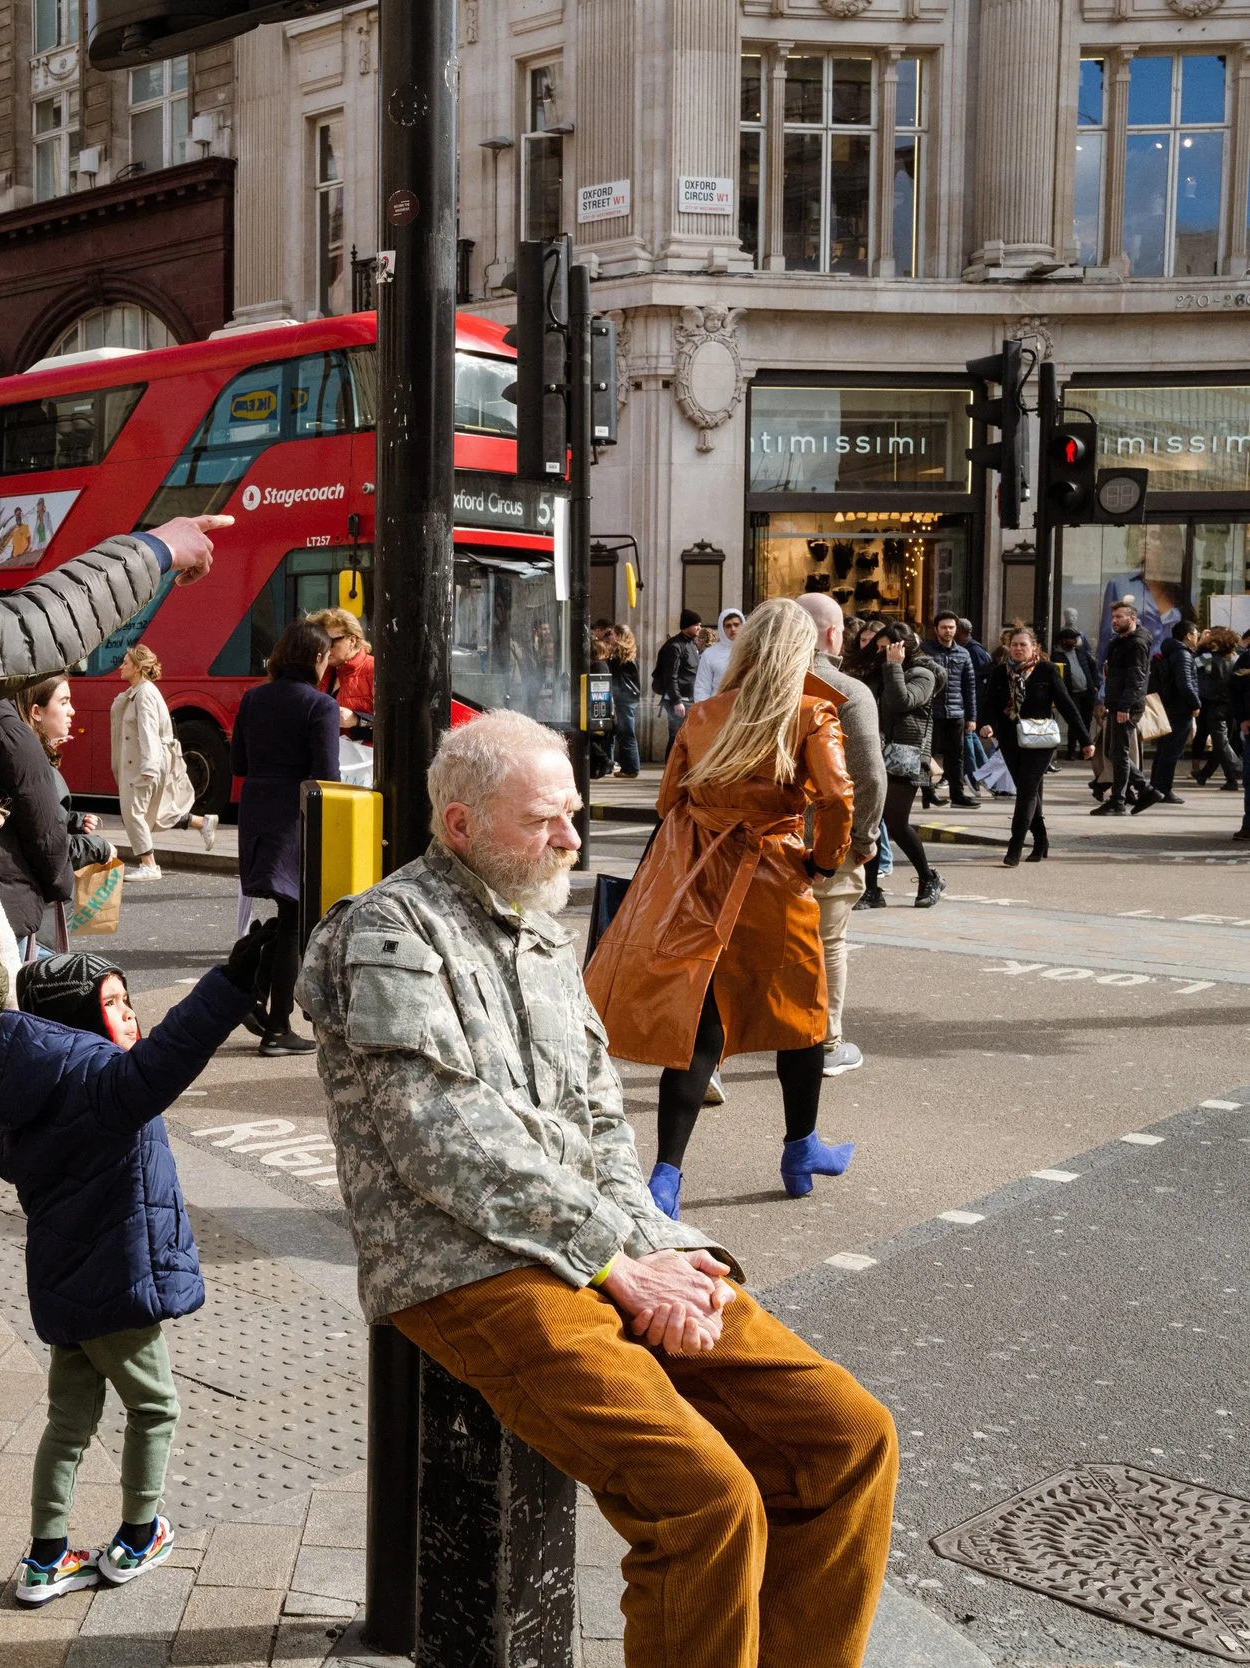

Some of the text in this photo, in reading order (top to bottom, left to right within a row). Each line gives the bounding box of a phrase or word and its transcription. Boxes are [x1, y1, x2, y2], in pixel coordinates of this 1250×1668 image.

[582, 186, 613, 200] OXFORD
[684, 180, 717, 191] OXFORD
[582, 195, 625, 211] STREET W1
[684, 191, 729, 203] CIRCUS W1
[750, 432, 926, 455] timissimi
[1103, 435, 1250, 455] imissim
[262, 482, 345, 508] Stagecoach
[453, 489, 555, 525] xford Circus 5
[306, 535, 331, 547] LT257
[592, 692, 608, 701] WAIT
[980, 960, 1218, 994] LOOK
[190, 1118, 340, 1187] RIG
